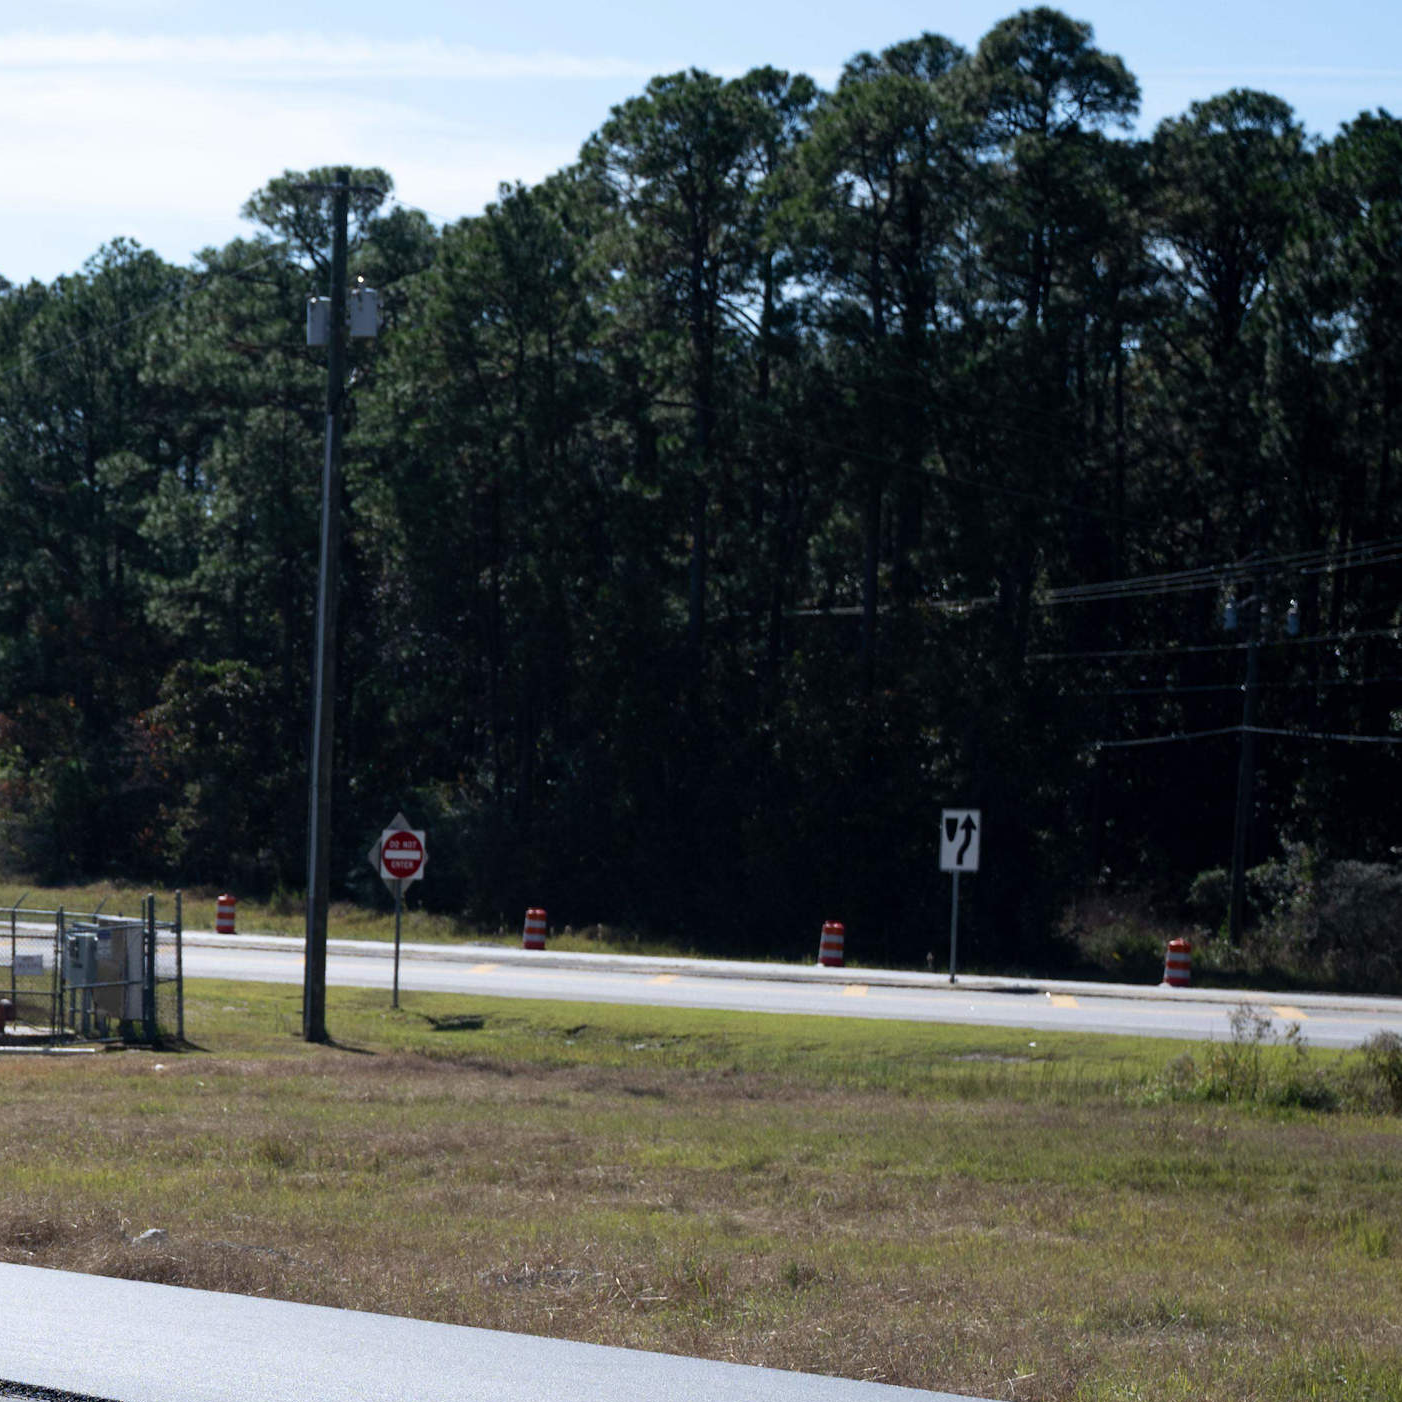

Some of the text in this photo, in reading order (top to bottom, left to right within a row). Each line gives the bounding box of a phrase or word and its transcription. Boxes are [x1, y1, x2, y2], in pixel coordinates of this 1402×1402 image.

[389, 840, 417, 848] DO NOT
[391, 860, 414, 869] ENTER
